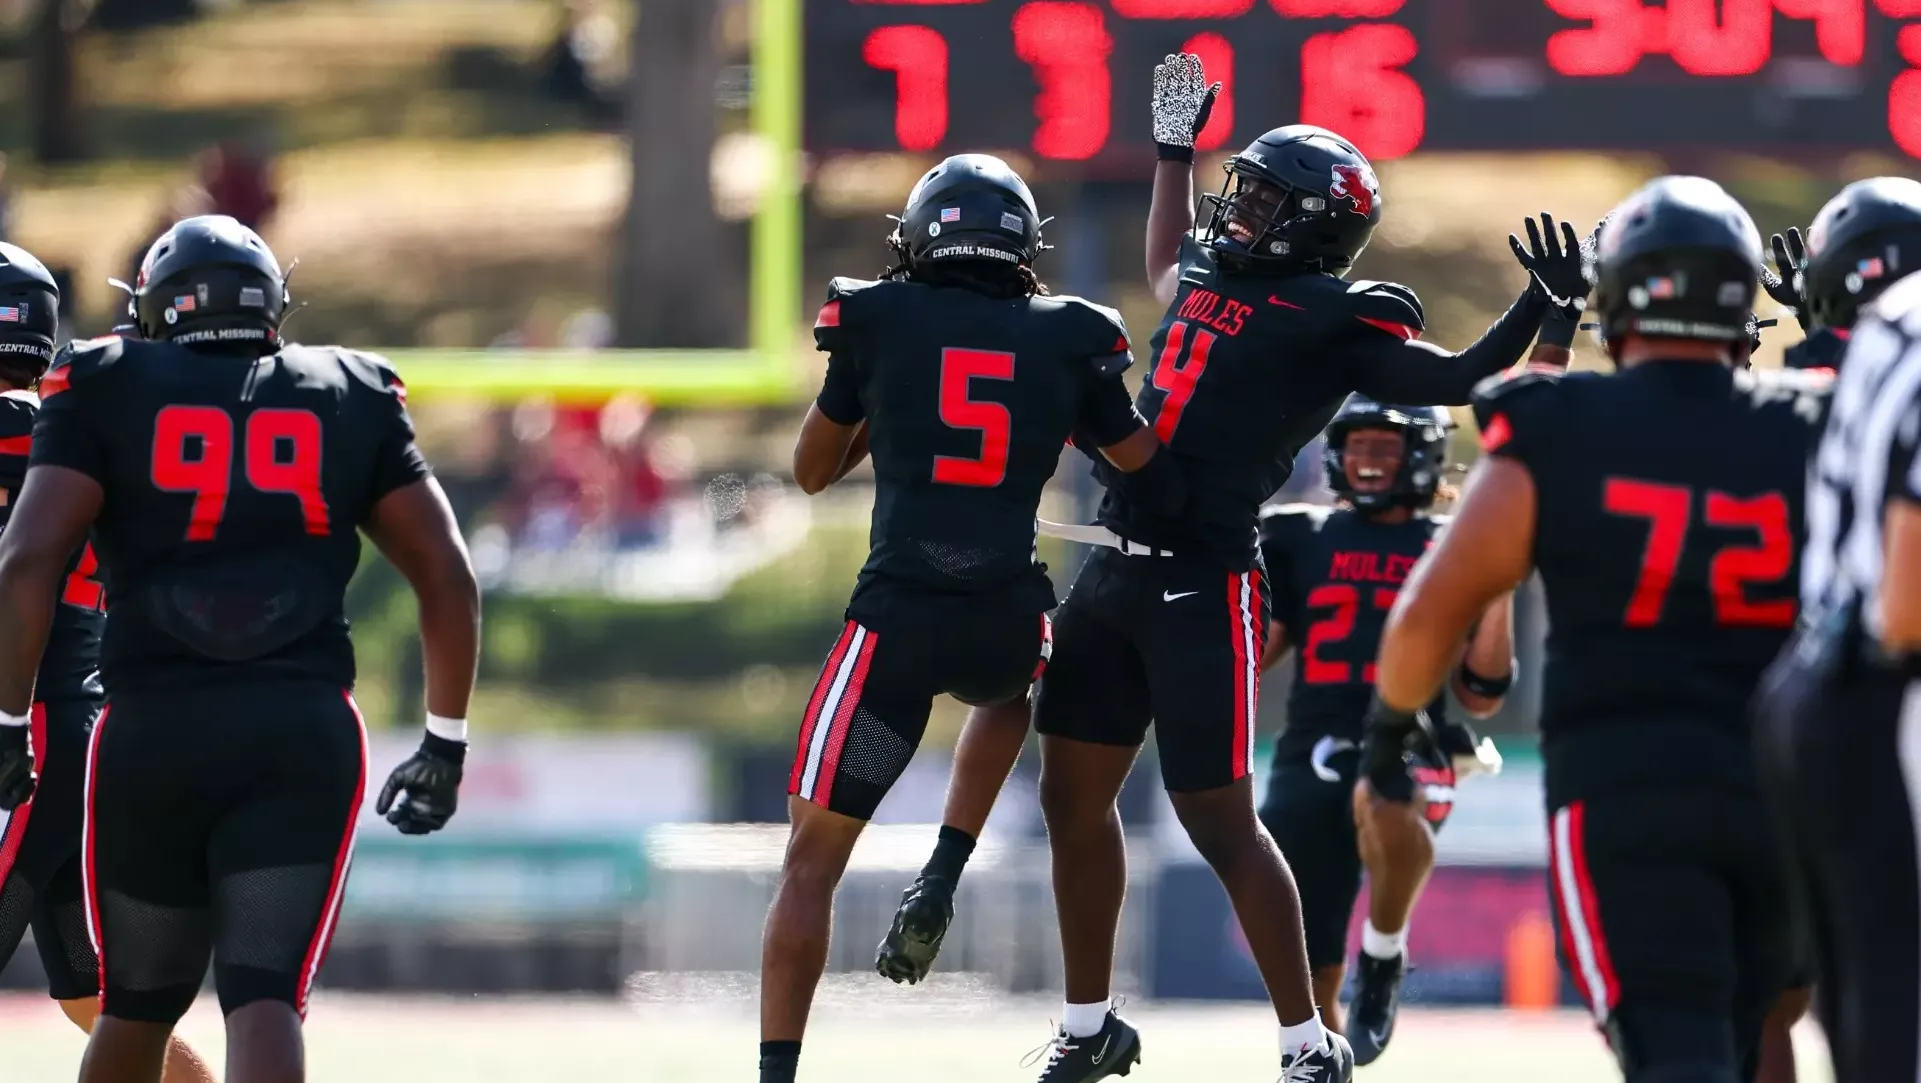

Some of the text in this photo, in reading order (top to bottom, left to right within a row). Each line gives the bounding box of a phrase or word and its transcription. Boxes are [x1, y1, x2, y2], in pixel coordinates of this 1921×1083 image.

[932, 246, 1019, 264] CENTRAL MISSOURI
[0, 343, 39, 355] CENTRAL
[218, 328, 265, 340] MISSOURI
[1177, 289, 1253, 336] MULES
[931, 347, 1016, 488] 5
[1153, 321, 1218, 445] 4
[151, 405, 331, 541] 99
[1604, 477, 1797, 629] 72
